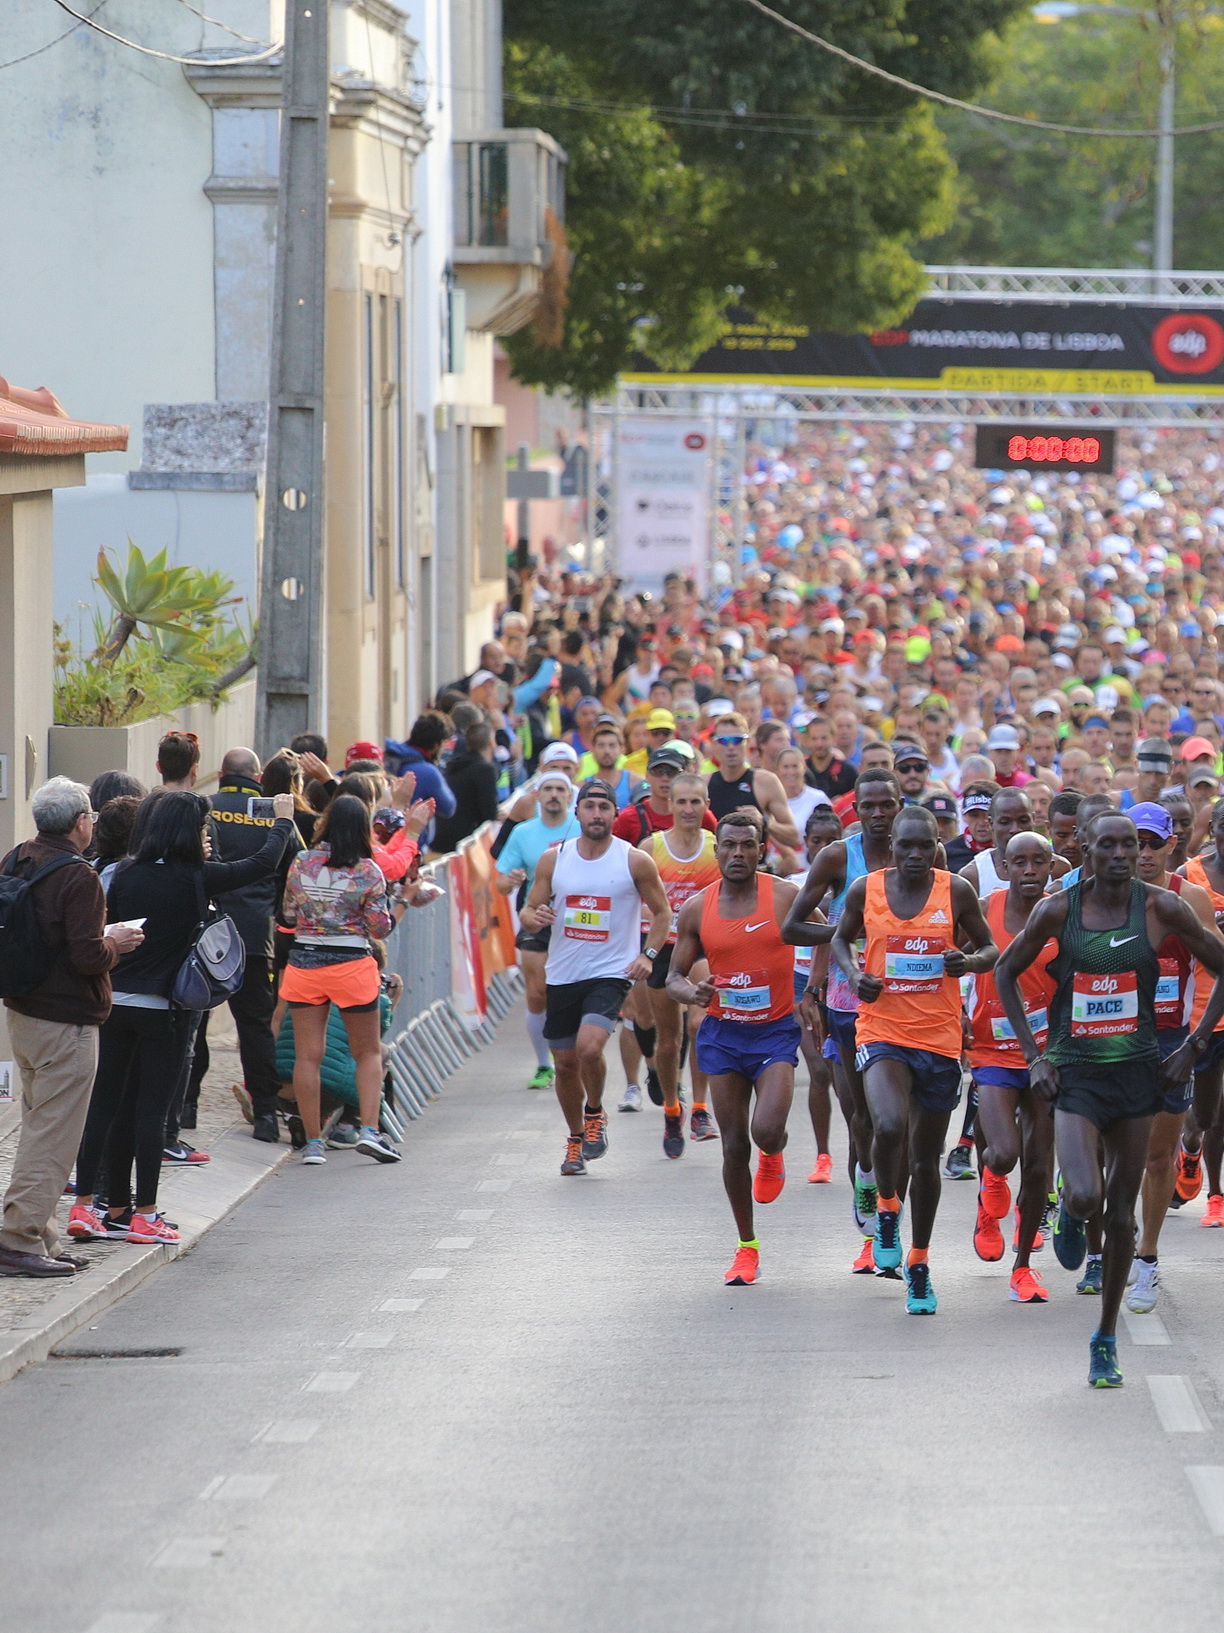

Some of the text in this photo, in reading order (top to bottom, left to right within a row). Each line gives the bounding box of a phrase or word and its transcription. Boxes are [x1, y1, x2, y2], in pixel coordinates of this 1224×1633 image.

[908, 329, 1021, 349] MARATONA
[1021, 331, 1051, 350] DE
[1052, 331, 1125, 351] LISBOA
[1076, 376, 1145, 390] START
[211, 810, 275, 828] ROSEGU
[580, 896, 598, 910] edp
[580, 912, 592, 925] 81
[574, 931, 607, 940] Santander
[904, 936, 929, 955] edp
[906, 962, 933, 972] NDIEMA
[730, 972, 752, 988] edp
[1091, 975, 1118, 994] edp
[898, 983, 940, 992] Santander
[1086, 1000, 1122, 1015] PACE
[730, 1012, 769, 1021] Santander
[1088, 1022, 1135, 1035] Santander
